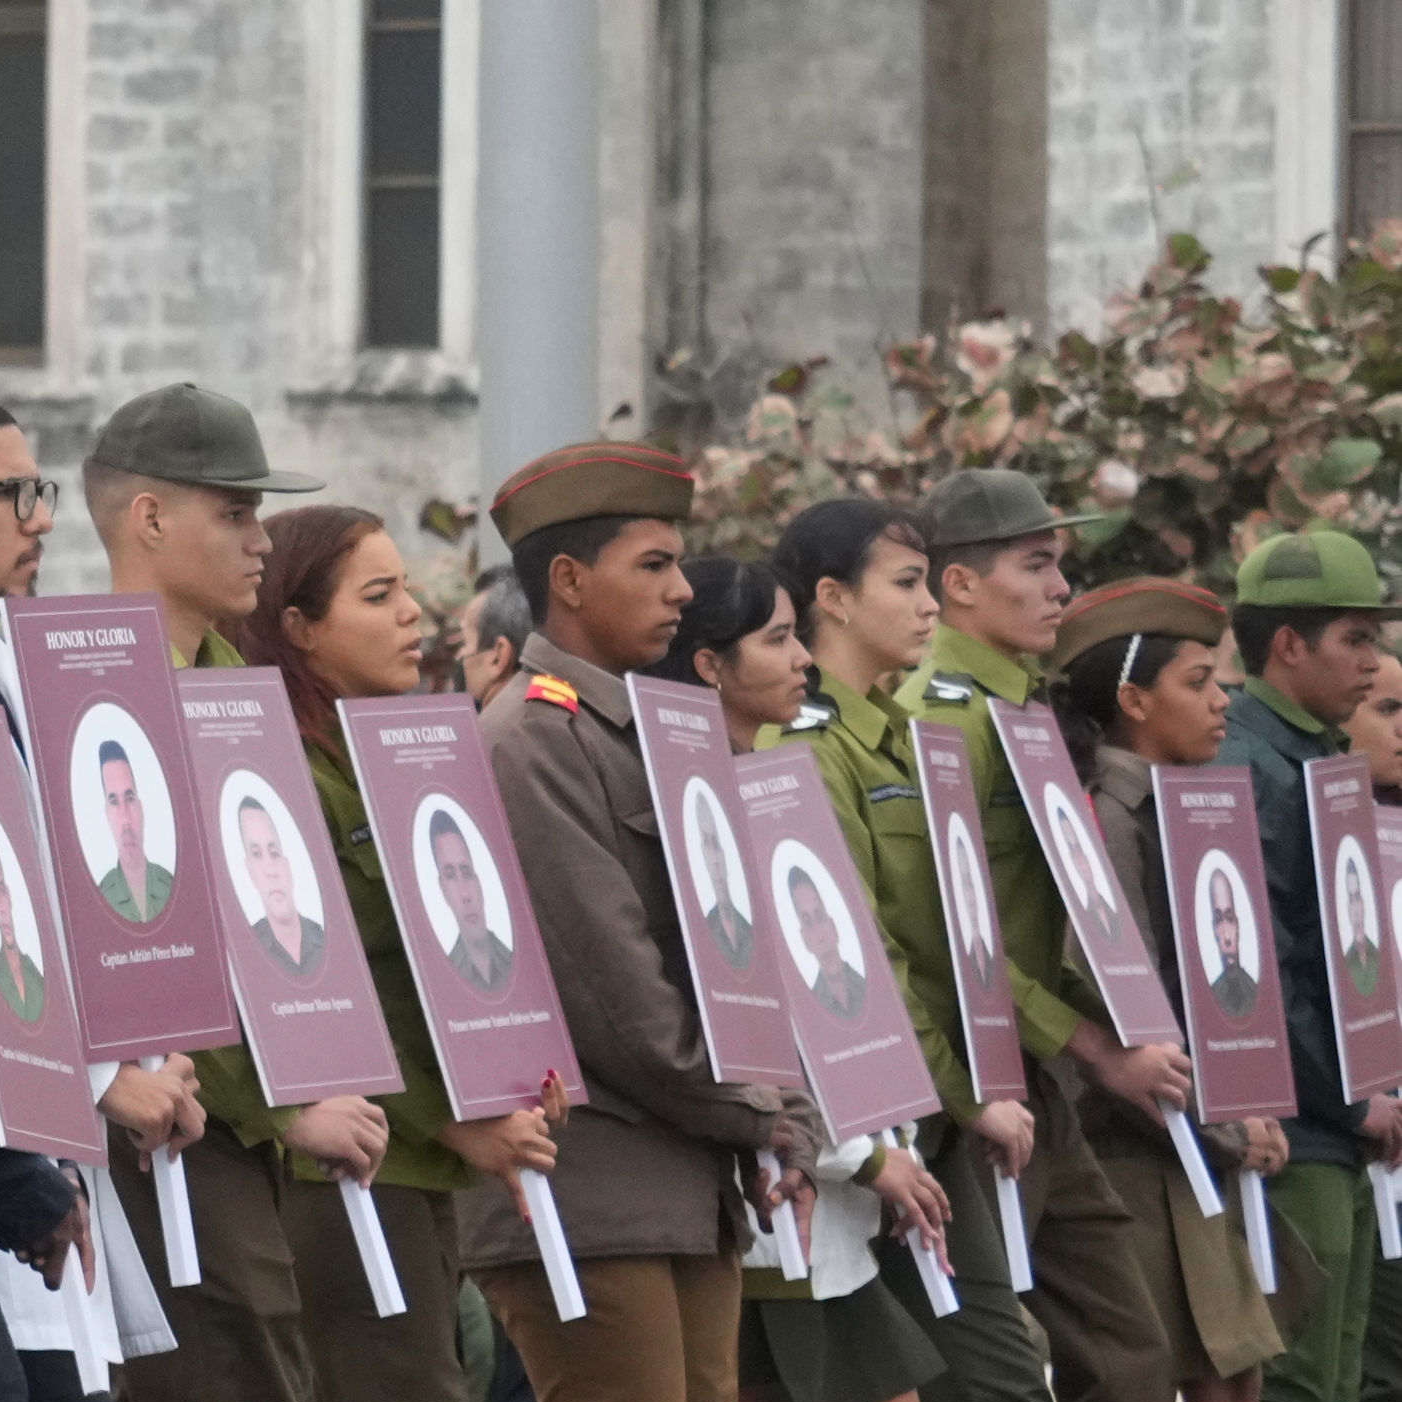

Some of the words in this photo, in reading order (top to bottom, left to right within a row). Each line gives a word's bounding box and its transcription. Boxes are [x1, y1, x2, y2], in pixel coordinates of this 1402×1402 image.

[45, 630, 87, 650] HONOR
[86, 630, 97, 648] Y
[96, 628, 137, 647] GLORIA
[183, 701, 219, 719] HONOR
[218, 701, 228, 717] Y
[227, 700, 264, 717] GLORIA
[379, 728, 413, 746] HONOR
[413, 727, 423, 744] Y
[422, 726, 457, 743] GLORIA
